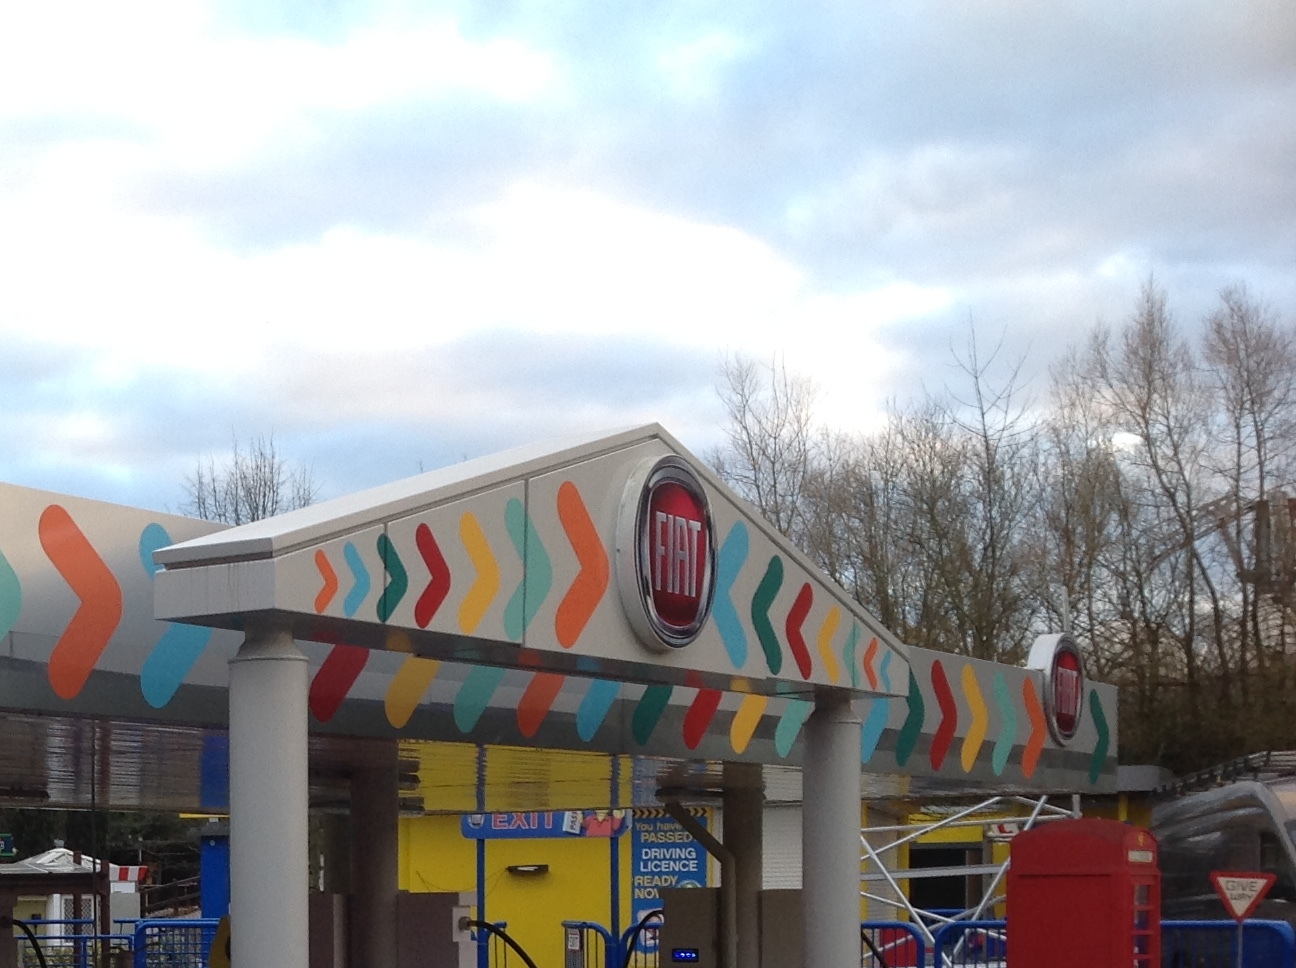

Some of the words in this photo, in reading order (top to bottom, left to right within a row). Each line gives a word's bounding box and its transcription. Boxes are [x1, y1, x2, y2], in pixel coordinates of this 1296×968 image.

[655, 510, 702, 598] FIAT
[492, 812, 553, 830] EXIT
[640, 831, 693, 843] PASSED
[641, 848, 696, 859] DRIVING
[640, 860, 698, 872] LICENCE
[634, 875, 678, 887] READY
[1226, 880, 1258, 892] GIVE
